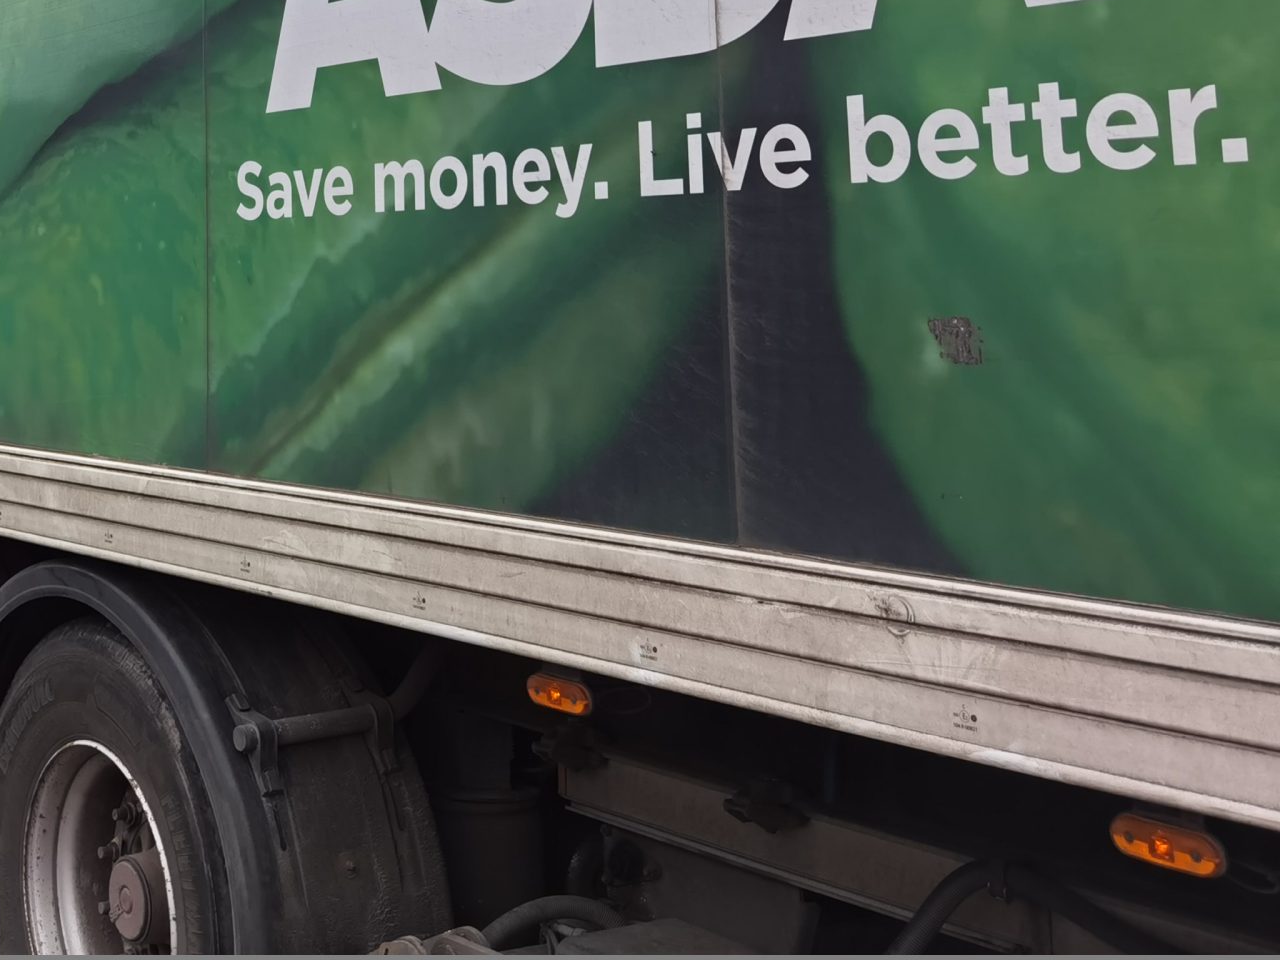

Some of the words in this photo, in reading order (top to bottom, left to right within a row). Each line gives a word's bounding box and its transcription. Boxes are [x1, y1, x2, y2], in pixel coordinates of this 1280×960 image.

[236, 160, 354, 221] Save
[374, 143, 609, 219] money.
[638, 112, 812, 197] Live
[846, 82, 1249, 185] better.
